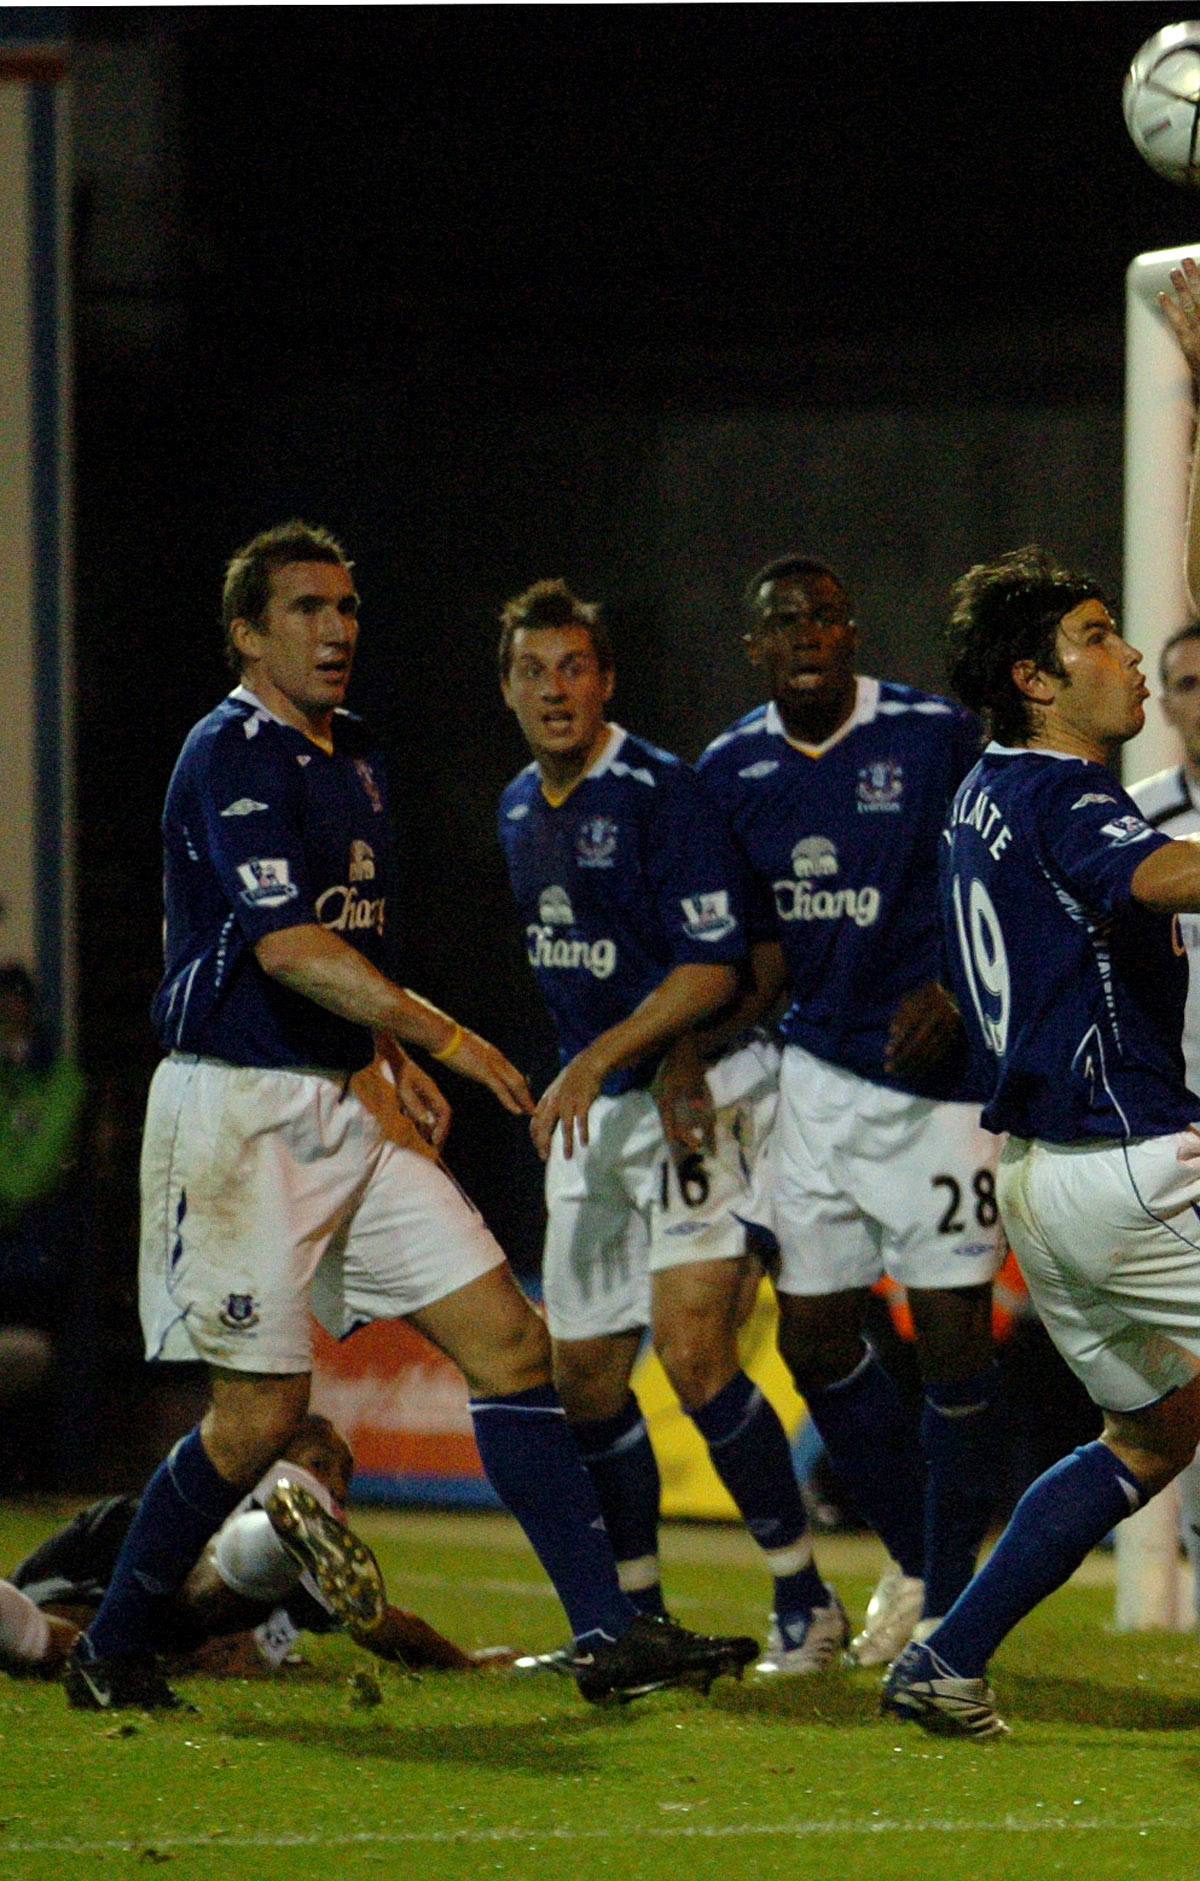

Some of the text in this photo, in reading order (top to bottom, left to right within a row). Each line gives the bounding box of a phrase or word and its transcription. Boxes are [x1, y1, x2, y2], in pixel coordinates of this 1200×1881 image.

[315, 885, 386, 937] Chan
[772, 879, 881, 927] Chang
[952, 873, 1011, 1056] 19
[659, 1153, 711, 1211] 16
[932, 1169, 999, 1234] 28
